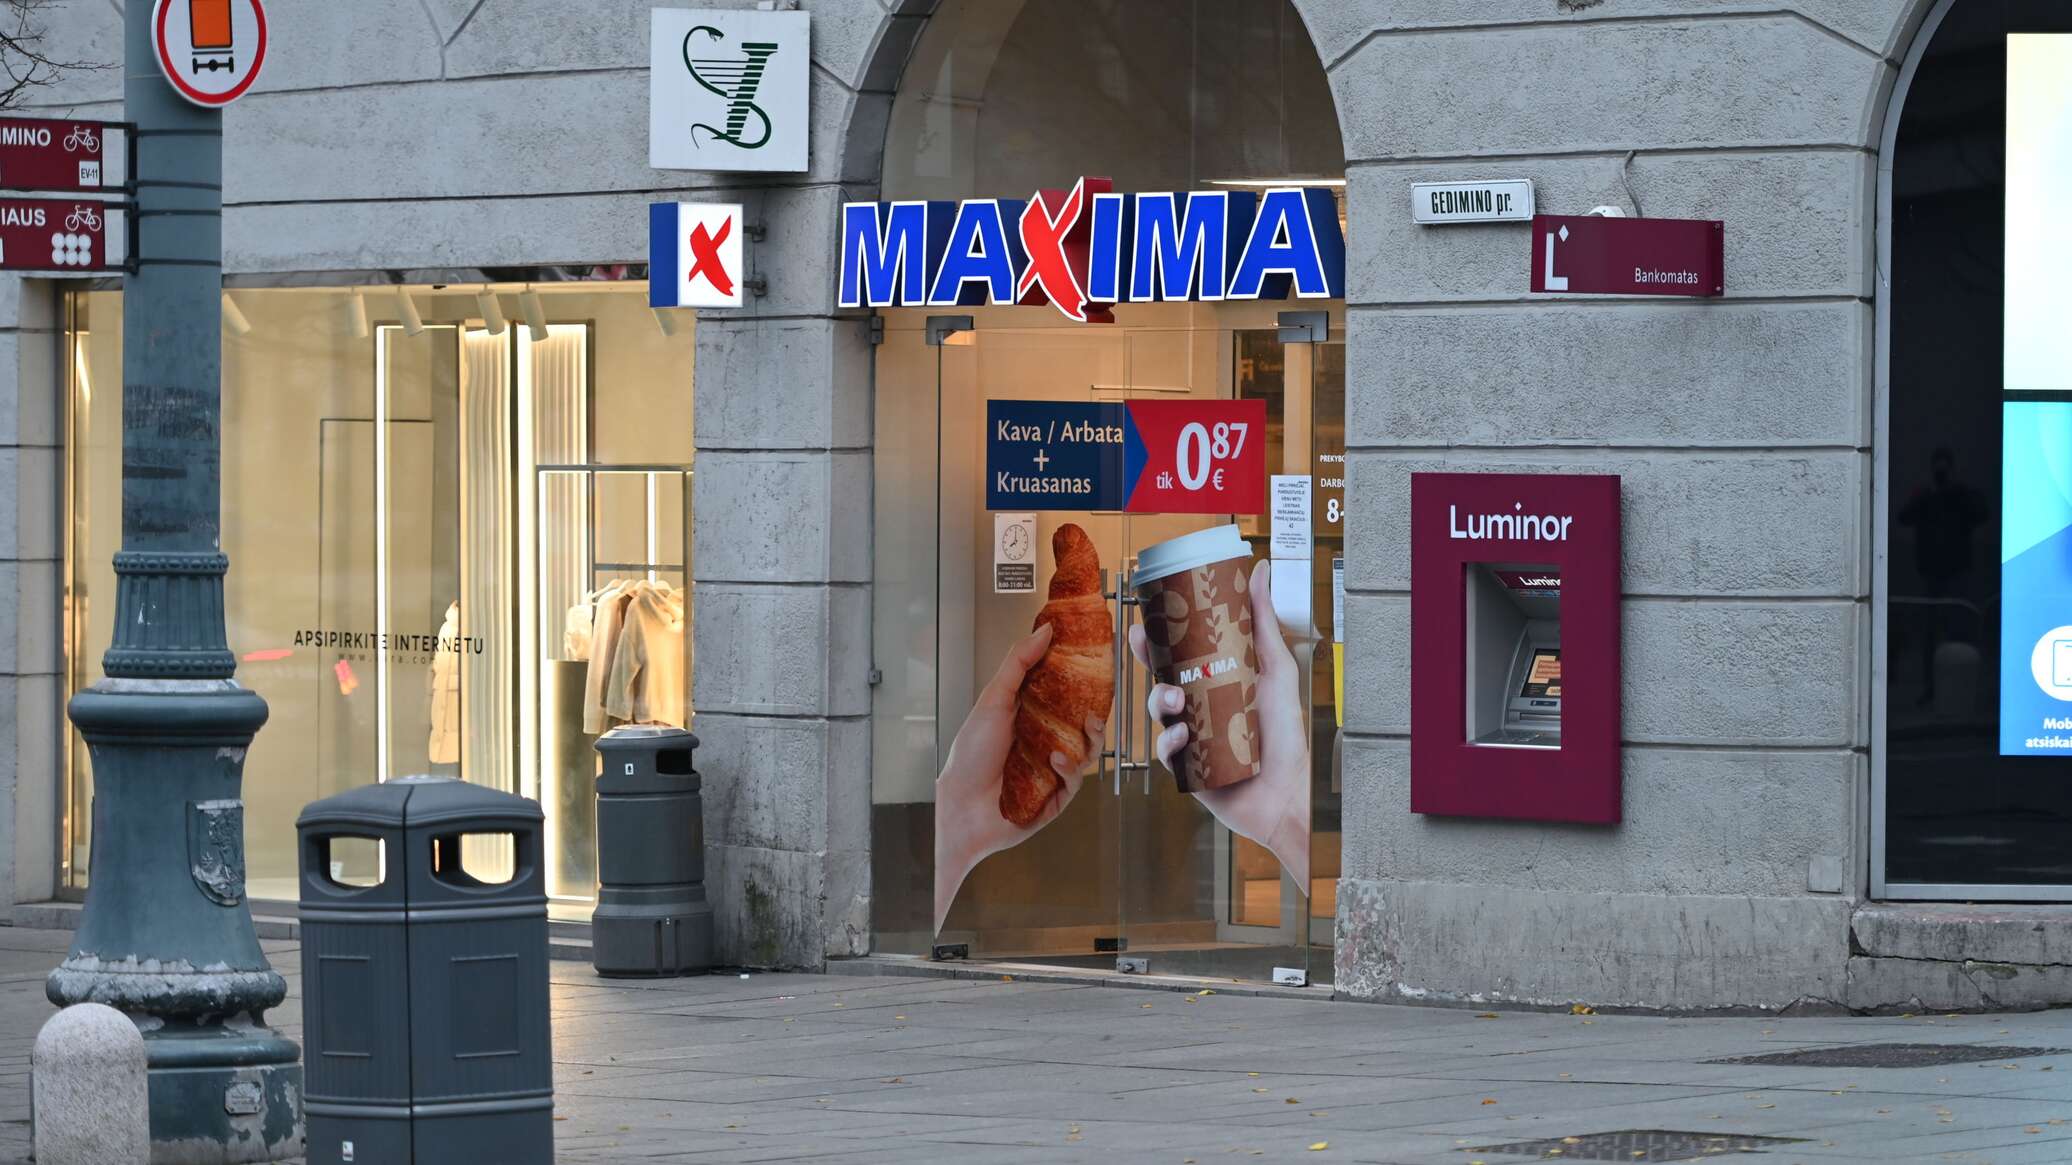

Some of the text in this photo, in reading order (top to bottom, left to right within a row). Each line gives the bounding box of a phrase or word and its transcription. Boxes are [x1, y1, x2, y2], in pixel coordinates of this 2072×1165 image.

[0, 127, 52, 147] MINO
[80, 168, 99, 179] EV-11
[1431, 189, 1512, 215] GEDIMINO pr.
[838, 176, 1332, 324] MAXIMA
[1634, 267, 1698, 284] Bankomatas
[997, 420, 1123, 444] Kava / Arbata
[997, 471, 1091, 494] Kruasanas
[1156, 471, 1173, 490] tik
[1212, 468, 1225, 490] €
[1450, 502, 1572, 541] Luminor
[294, 630, 484, 655] APSIPIRKITE INTERNETU
[1180, 657, 1239, 684] MAXIMA
